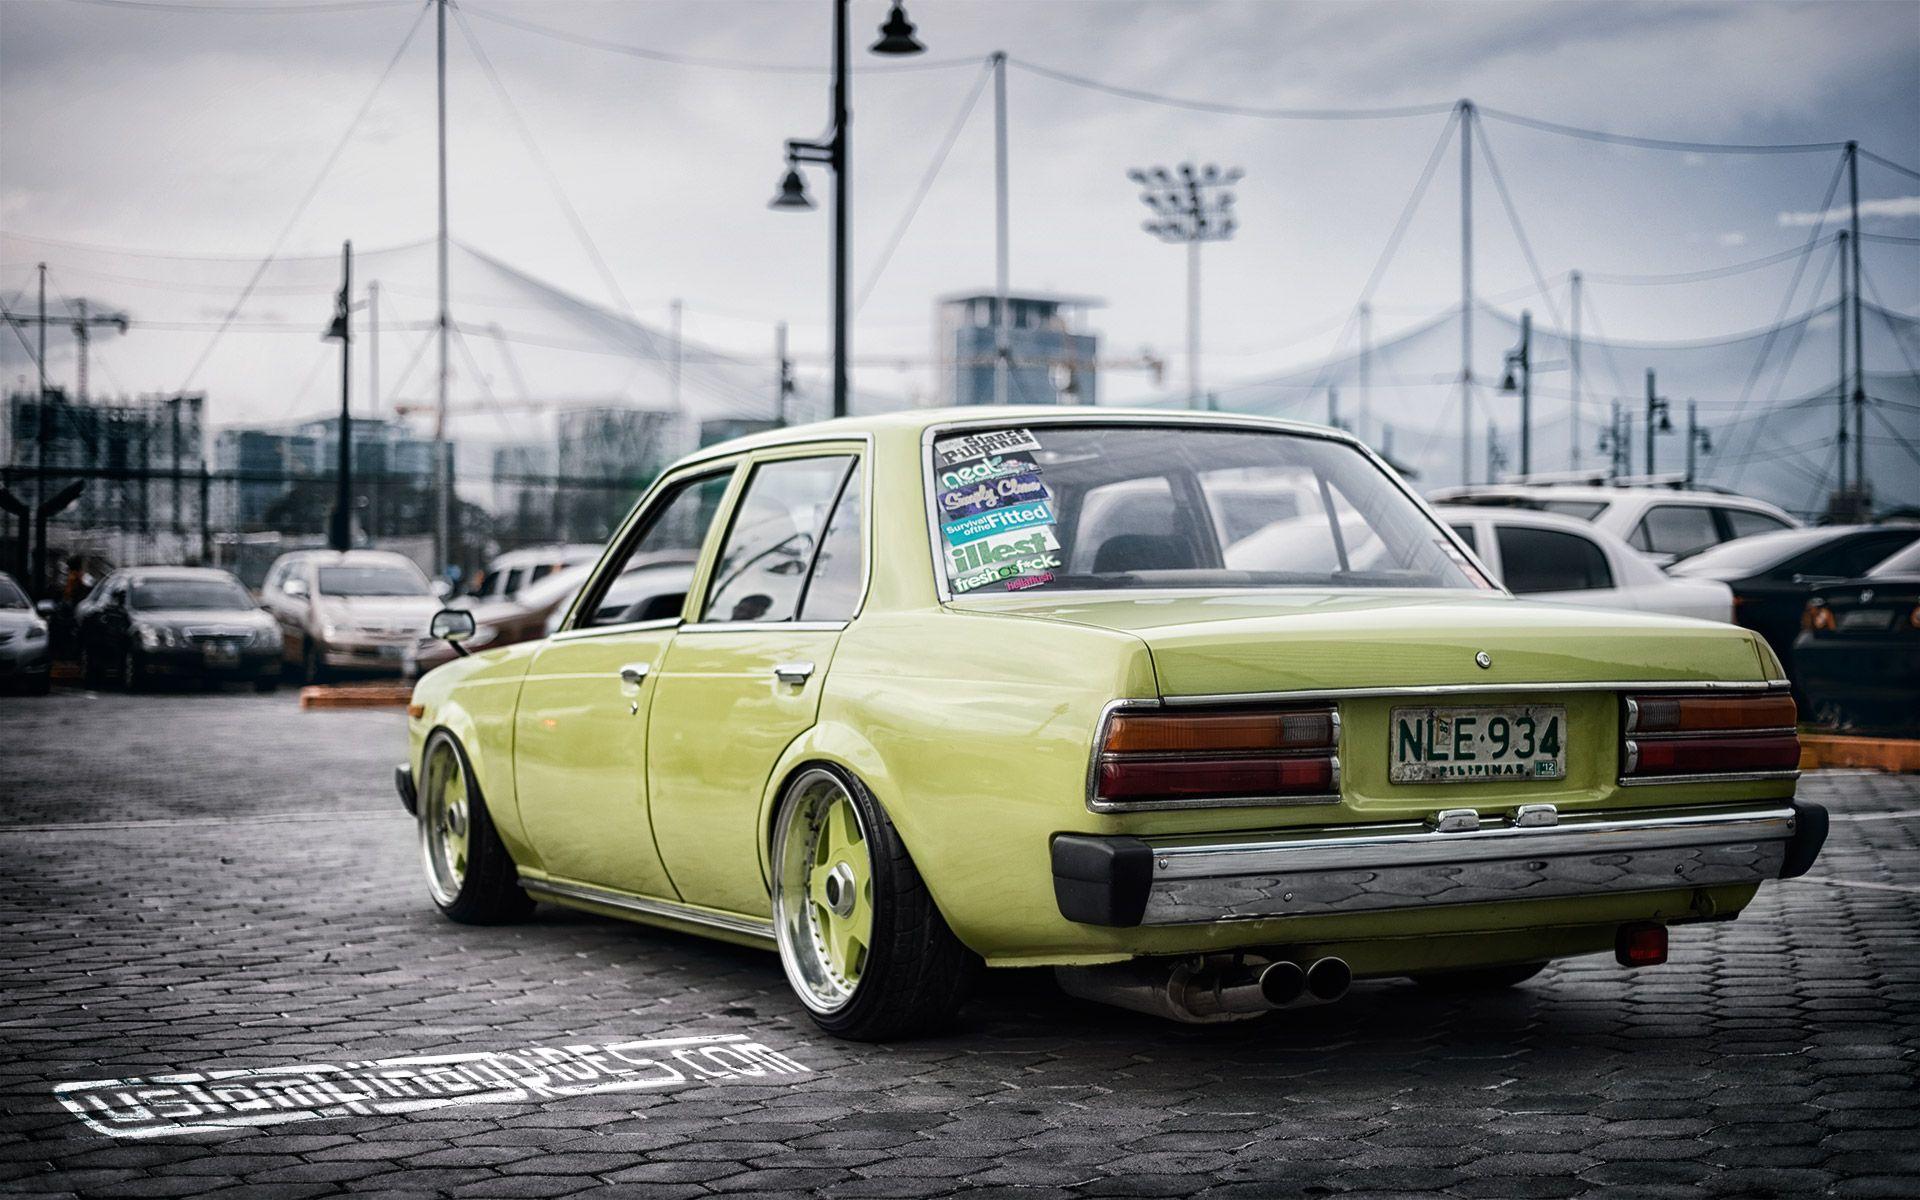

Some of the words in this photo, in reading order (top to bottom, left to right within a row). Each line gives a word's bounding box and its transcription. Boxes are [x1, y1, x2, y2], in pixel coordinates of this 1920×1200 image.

[942, 436, 1034, 464] Pilipinas
[941, 456, 1002, 490] neat
[946, 516, 988, 534] Survival
[987, 505, 1048, 528] Fitted
[951, 532, 1048, 573] illest
[1439, 764, 1524, 776] PILIPINAS
